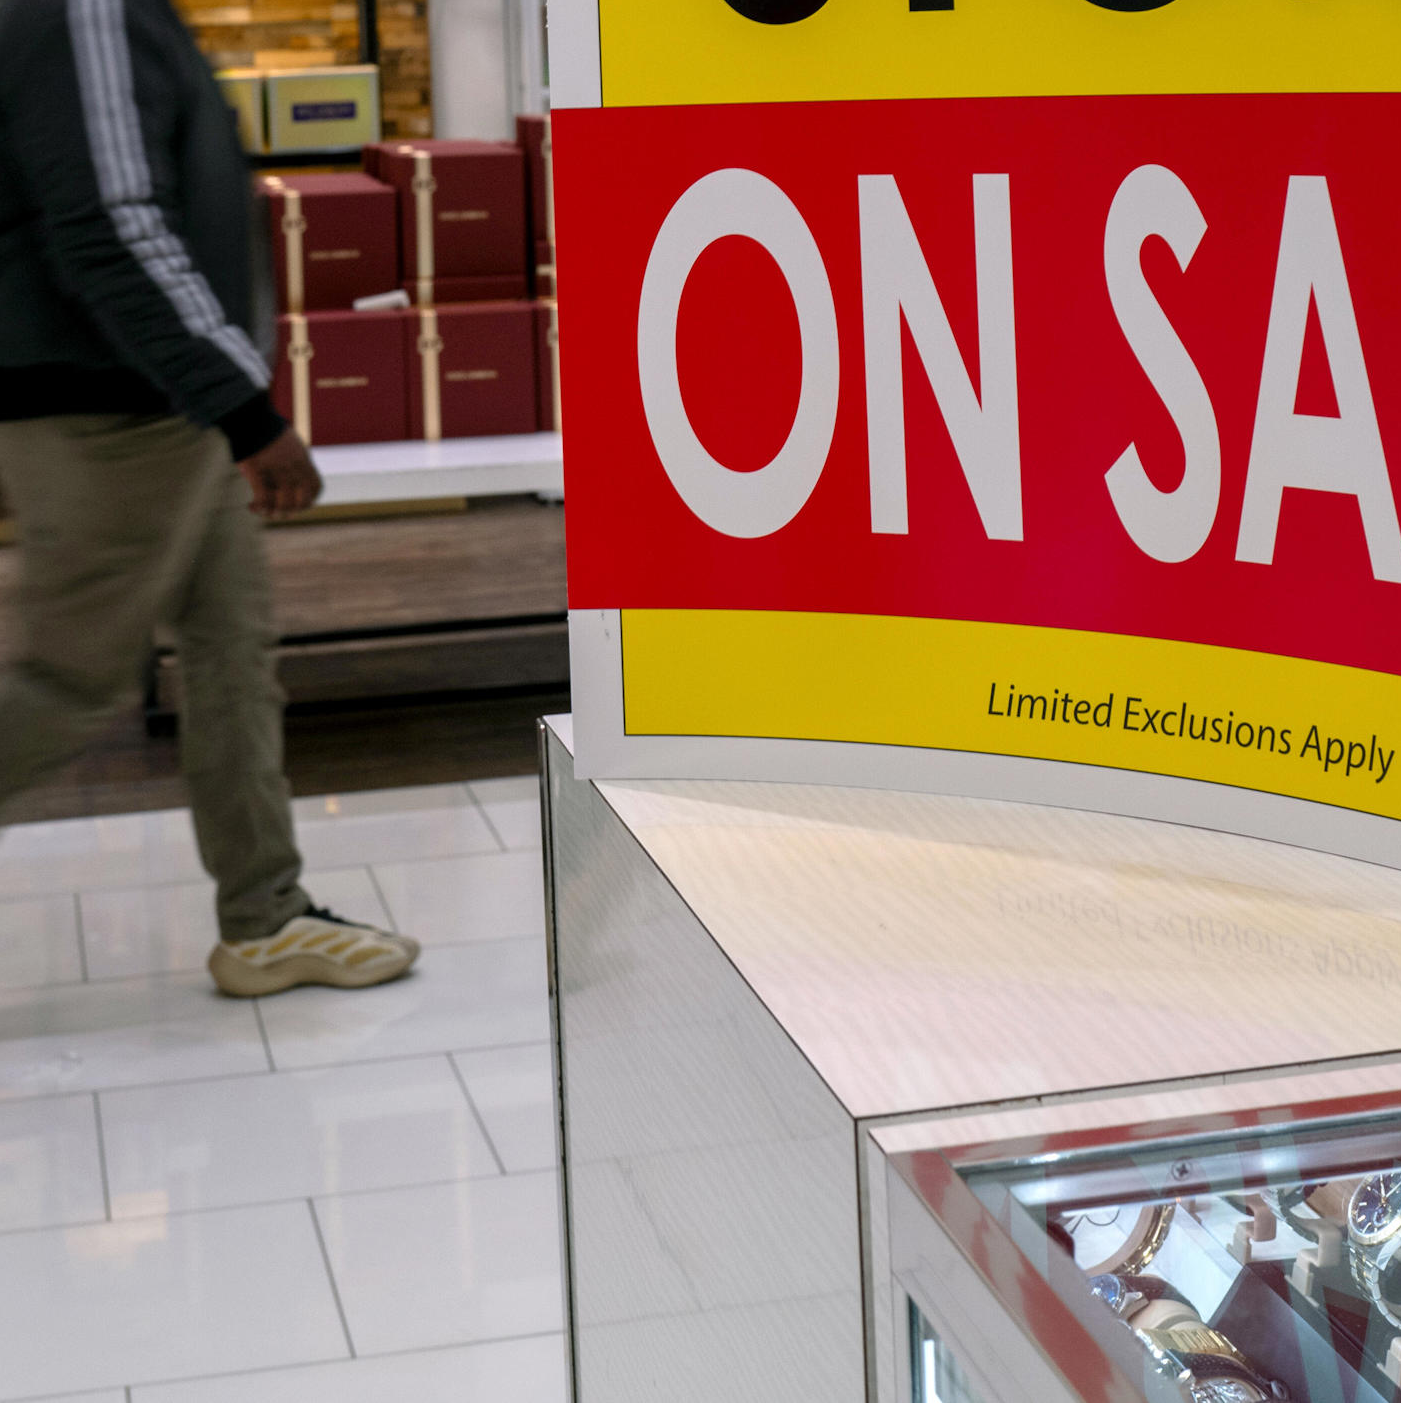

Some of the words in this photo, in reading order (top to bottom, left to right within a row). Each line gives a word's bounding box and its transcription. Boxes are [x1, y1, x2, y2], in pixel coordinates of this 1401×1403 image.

[638, 168, 1024, 542] ON
[987, 682, 1114, 728] Limited
[1123, 696, 1293, 755] Exclusions
[1300, 724, 1395, 784] Apply
